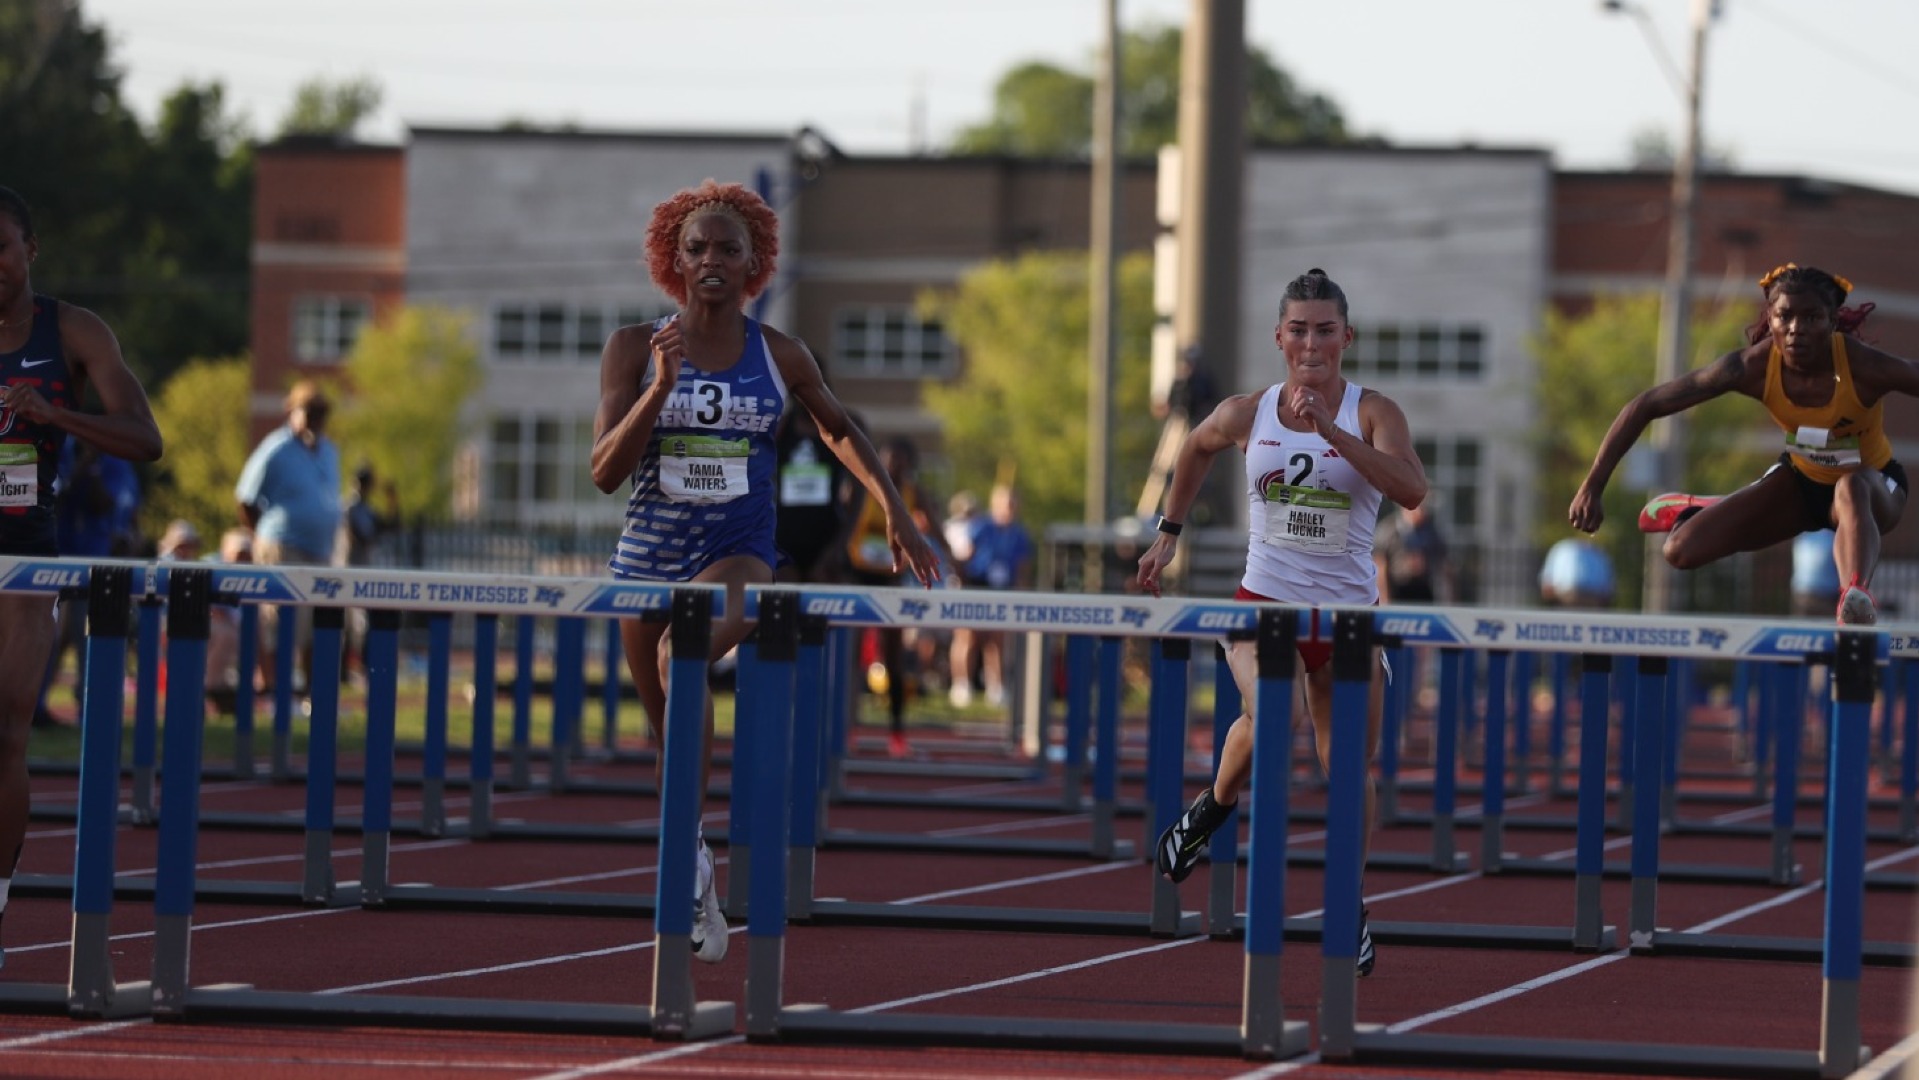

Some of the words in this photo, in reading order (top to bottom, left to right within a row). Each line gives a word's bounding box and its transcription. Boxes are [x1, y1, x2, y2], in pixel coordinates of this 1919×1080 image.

[697, 383, 723, 425] 3
[689, 463, 724, 476] TAMIA
[1289, 453, 1314, 488] 2
[683, 477, 727, 490] WATERS
[1289, 510, 1325, 525] HAILEY
[1286, 523, 1326, 538] TUCKER
[32, 569, 81, 586] GILL
[219, 576, 268, 593] GILL
[353, 581, 420, 600] MIDDLE
[427, 583, 528, 604] TENNESSEE
[612, 592, 661, 609] GILL
[807, 598, 856, 616] GILL
[940, 602, 1007, 622] MIDDLE
[1013, 605, 1114, 625] TENNESSEE
[1198, 610, 1247, 629] GILL
[1381, 618, 1431, 636] GILL
[1516, 622, 1583, 642] MIDDLE
[1589, 626, 1691, 646] TENNESSEE
[1776, 634, 1825, 651] GILL
